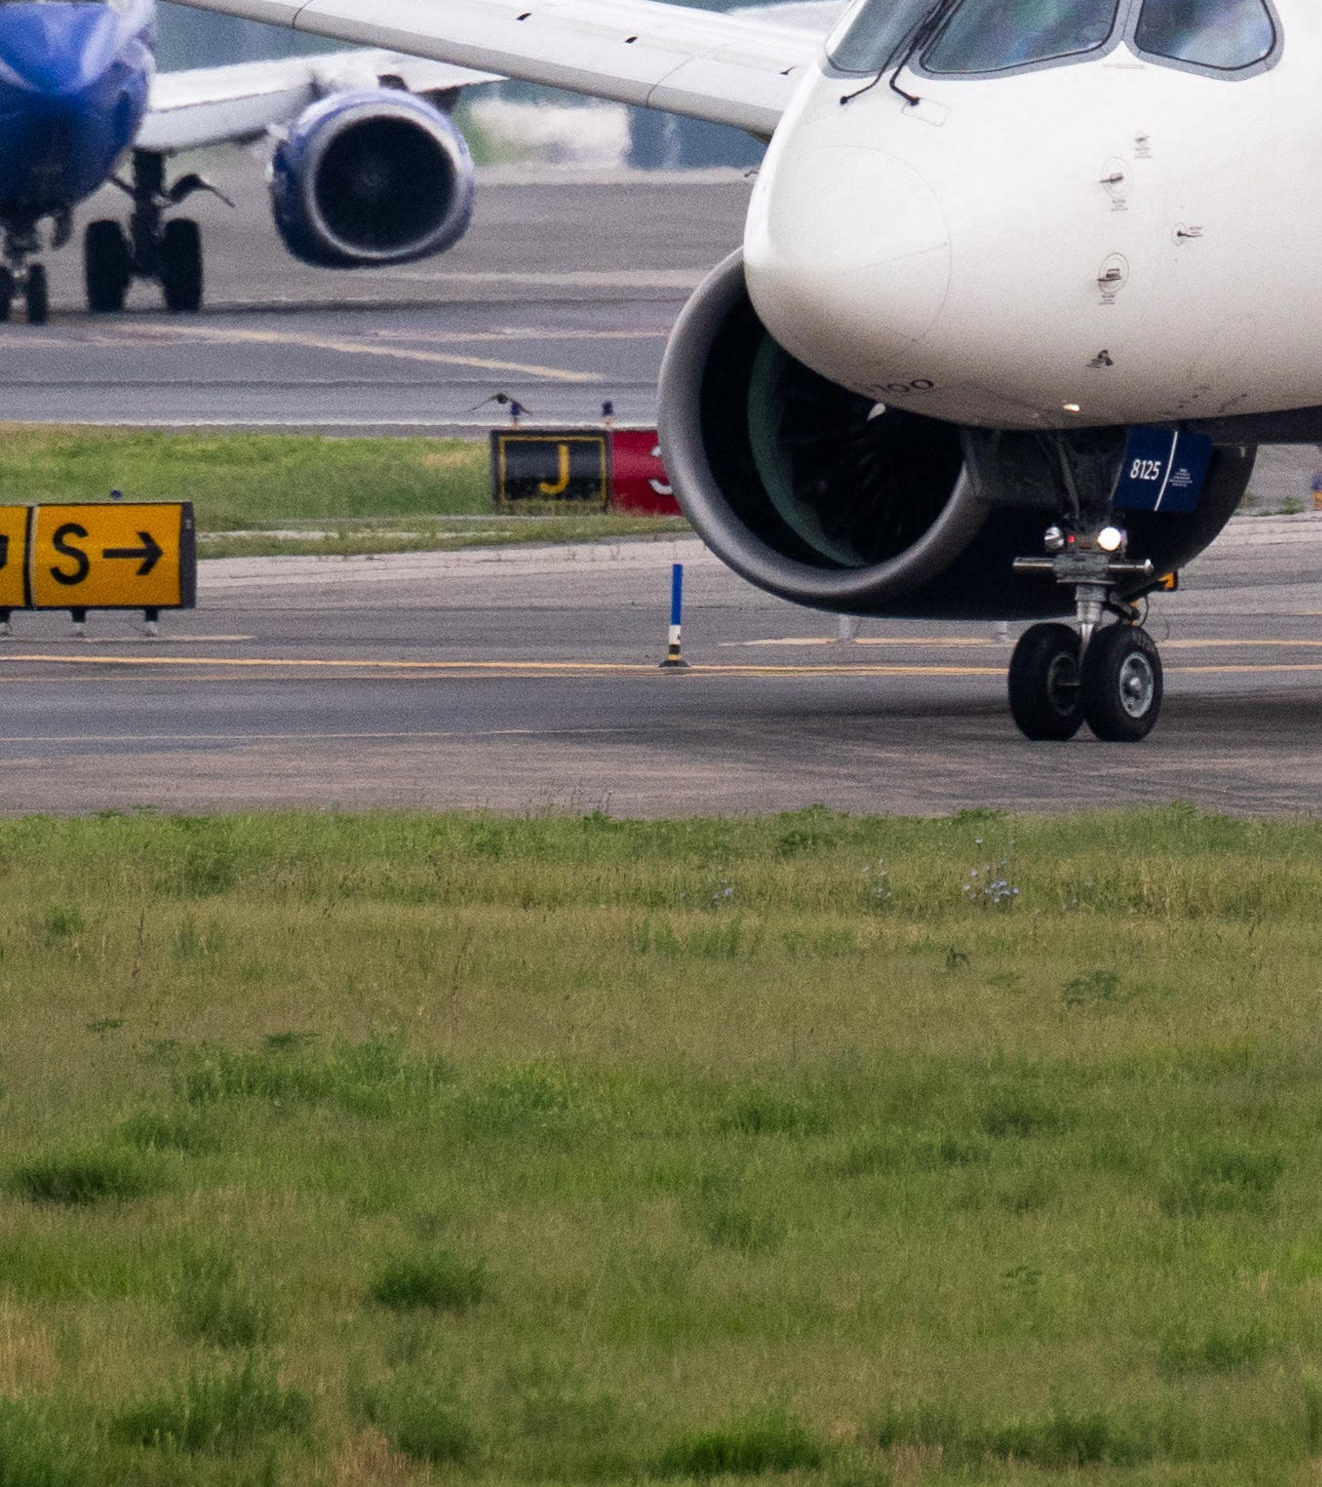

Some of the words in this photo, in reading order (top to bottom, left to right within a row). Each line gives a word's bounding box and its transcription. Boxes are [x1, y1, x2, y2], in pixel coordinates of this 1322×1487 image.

[538, 444, 570, 495] J
[1129, 458, 1162, 481] 8125
[50, 523, 90, 586] S
